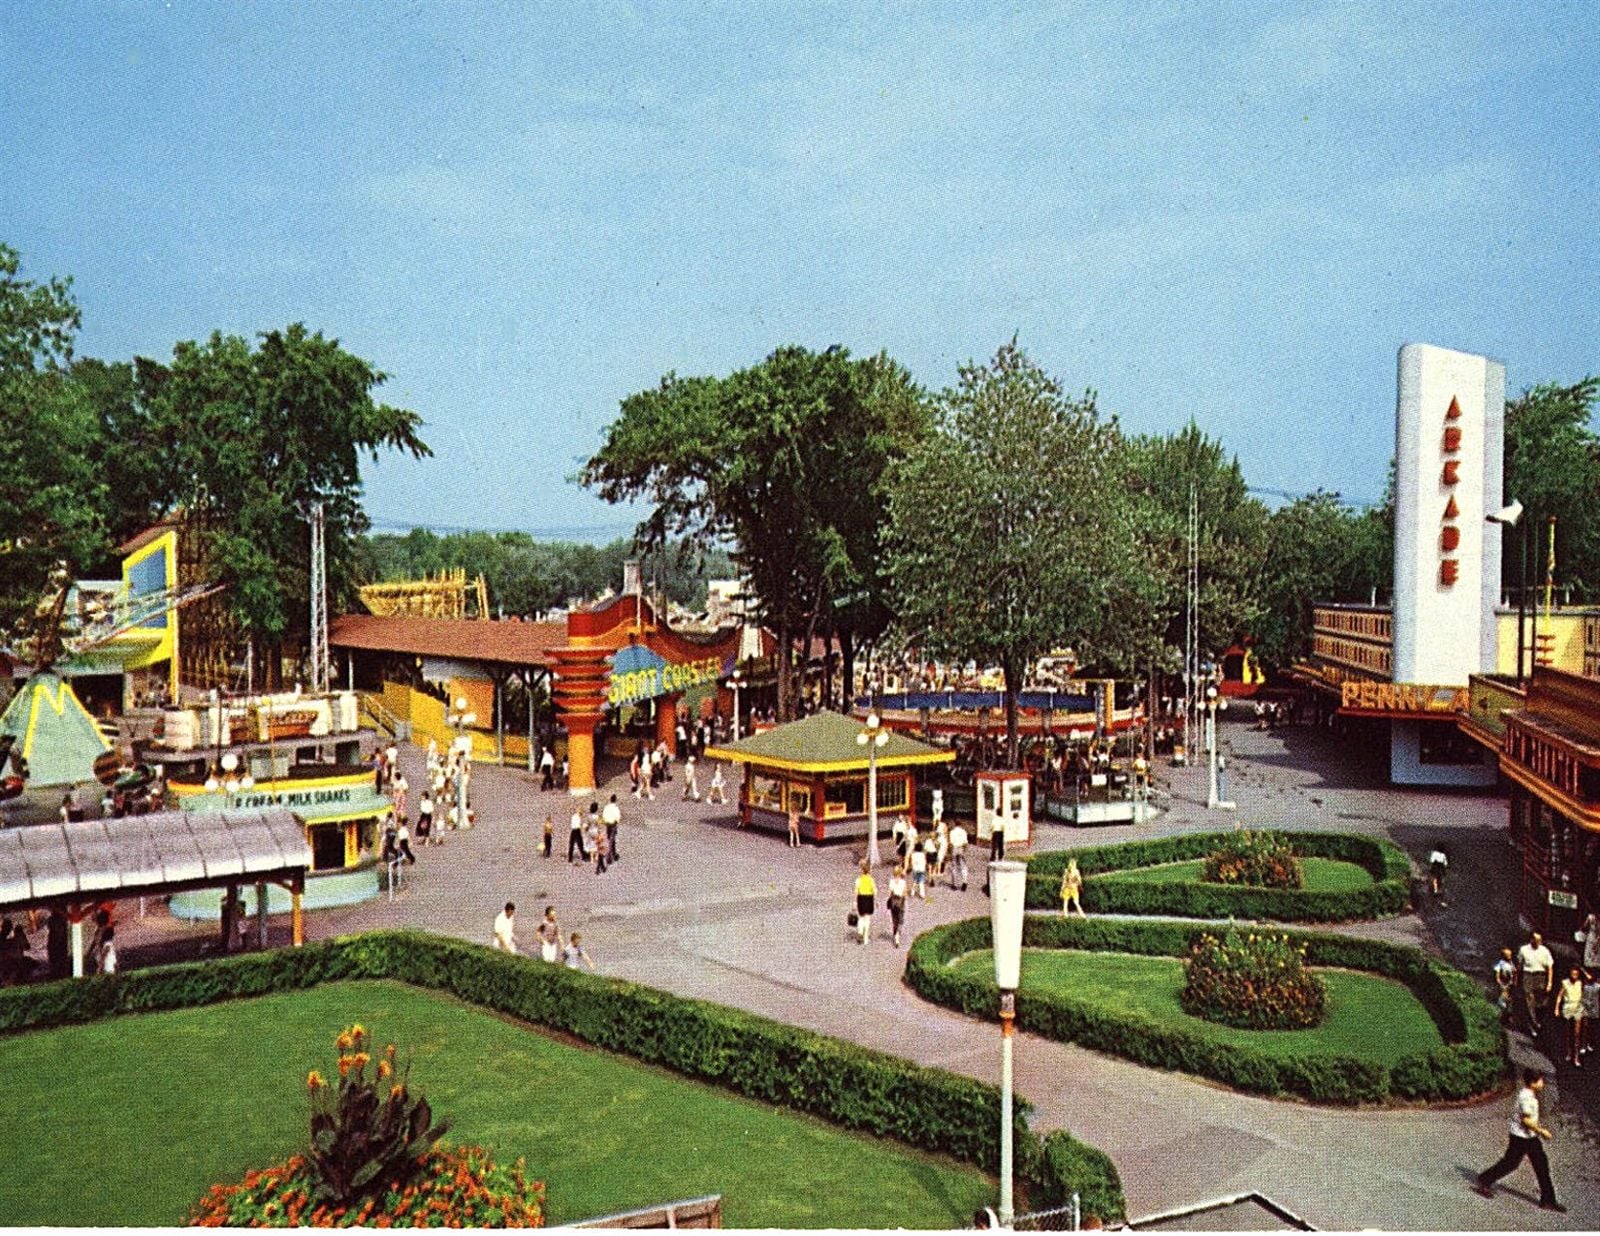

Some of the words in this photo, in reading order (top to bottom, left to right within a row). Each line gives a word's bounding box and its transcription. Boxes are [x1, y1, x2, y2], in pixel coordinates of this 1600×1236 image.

[1440, 394, 1463, 587] ARCADE
[607, 668, 657, 704] GIANT
[662, 656, 721, 690] COASTER
[288, 792, 312, 806] MILK
[314, 789, 351, 805] SHAKES
